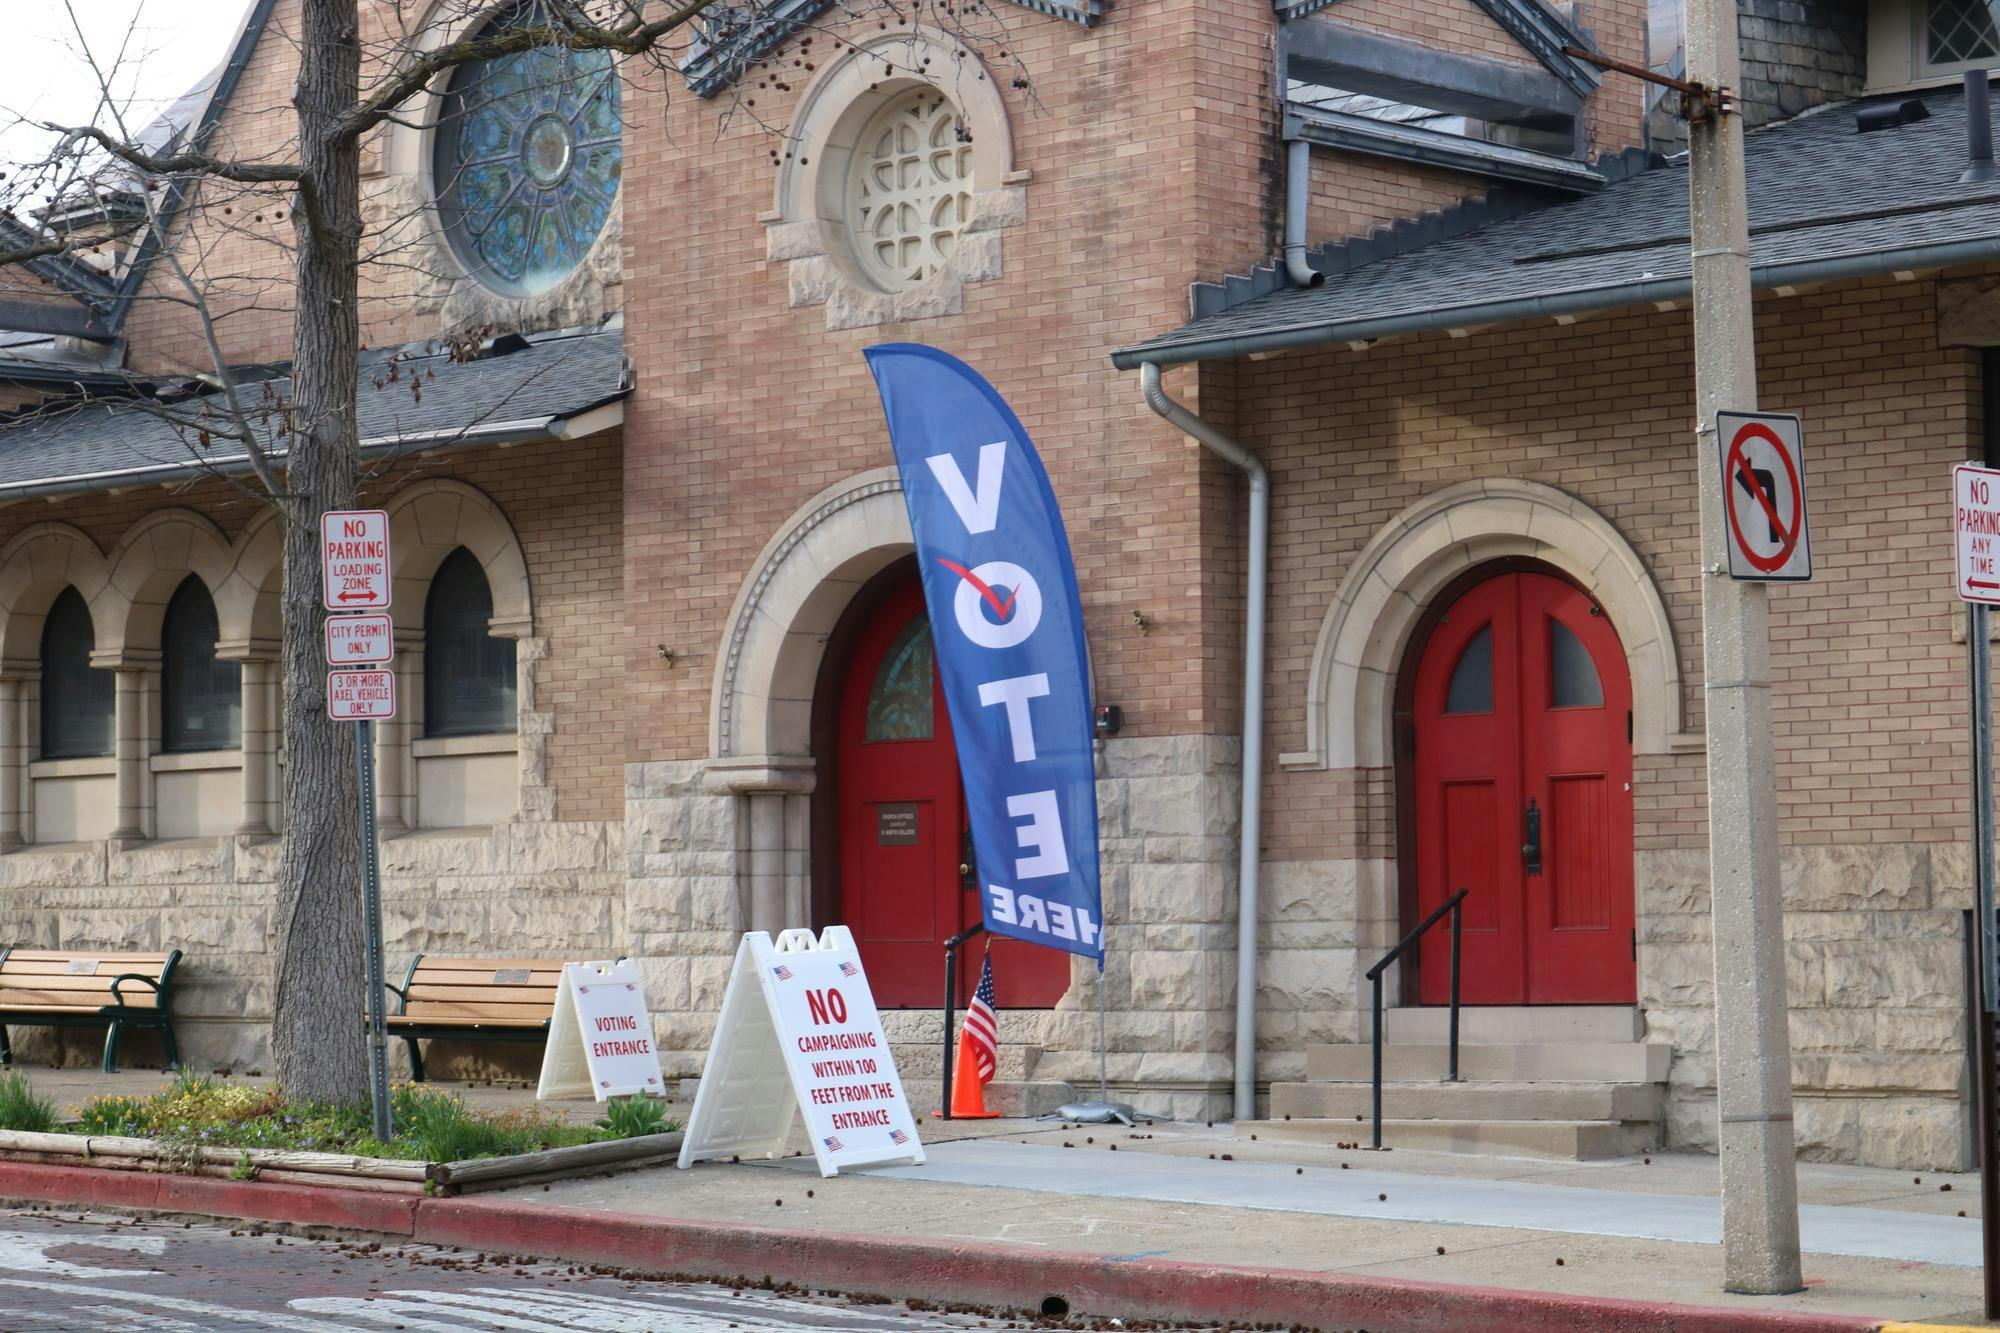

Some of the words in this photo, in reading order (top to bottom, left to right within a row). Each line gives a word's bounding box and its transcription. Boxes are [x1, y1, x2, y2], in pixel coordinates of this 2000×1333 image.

[1970, 480, 1989, 506] NO
[344, 520, 366, 538] NO
[328, 541, 384, 560] PARKING
[1971, 537, 1991, 554] ANY
[333, 563, 382, 577] LOADING
[1970, 556, 1994, 575] TIME
[342, 577, 372, 590] ZONE
[331, 626, 352, 639] CITY
[354, 624, 386, 637] PERMIT
[347, 641, 372, 654] ONLY
[337, 676, 343, 688] 3
[346, 676, 358, 688] OR
[361, 674, 385, 687] MORE
[334, 689, 354, 702] AXEL
[357, 688, 389, 701] VEHICLE
[350, 702, 374, 714] ONLY
[805, 988, 848, 1026] NO
[595, 1015, 637, 1032] VOTING
[593, 1039, 650, 1057] ENTRANCE
[797, 1031, 877, 1053] CAMPAIGNING
[812, 1060, 856, 1078] WITHIN
[857, 1058, 877, 1074] 100
[811, 1087, 840, 1105] FEET
[840, 1085, 873, 1103] FROM
[871, 1082, 895, 1099] THE
[832, 1109, 890, 1130] ENTRANCE
